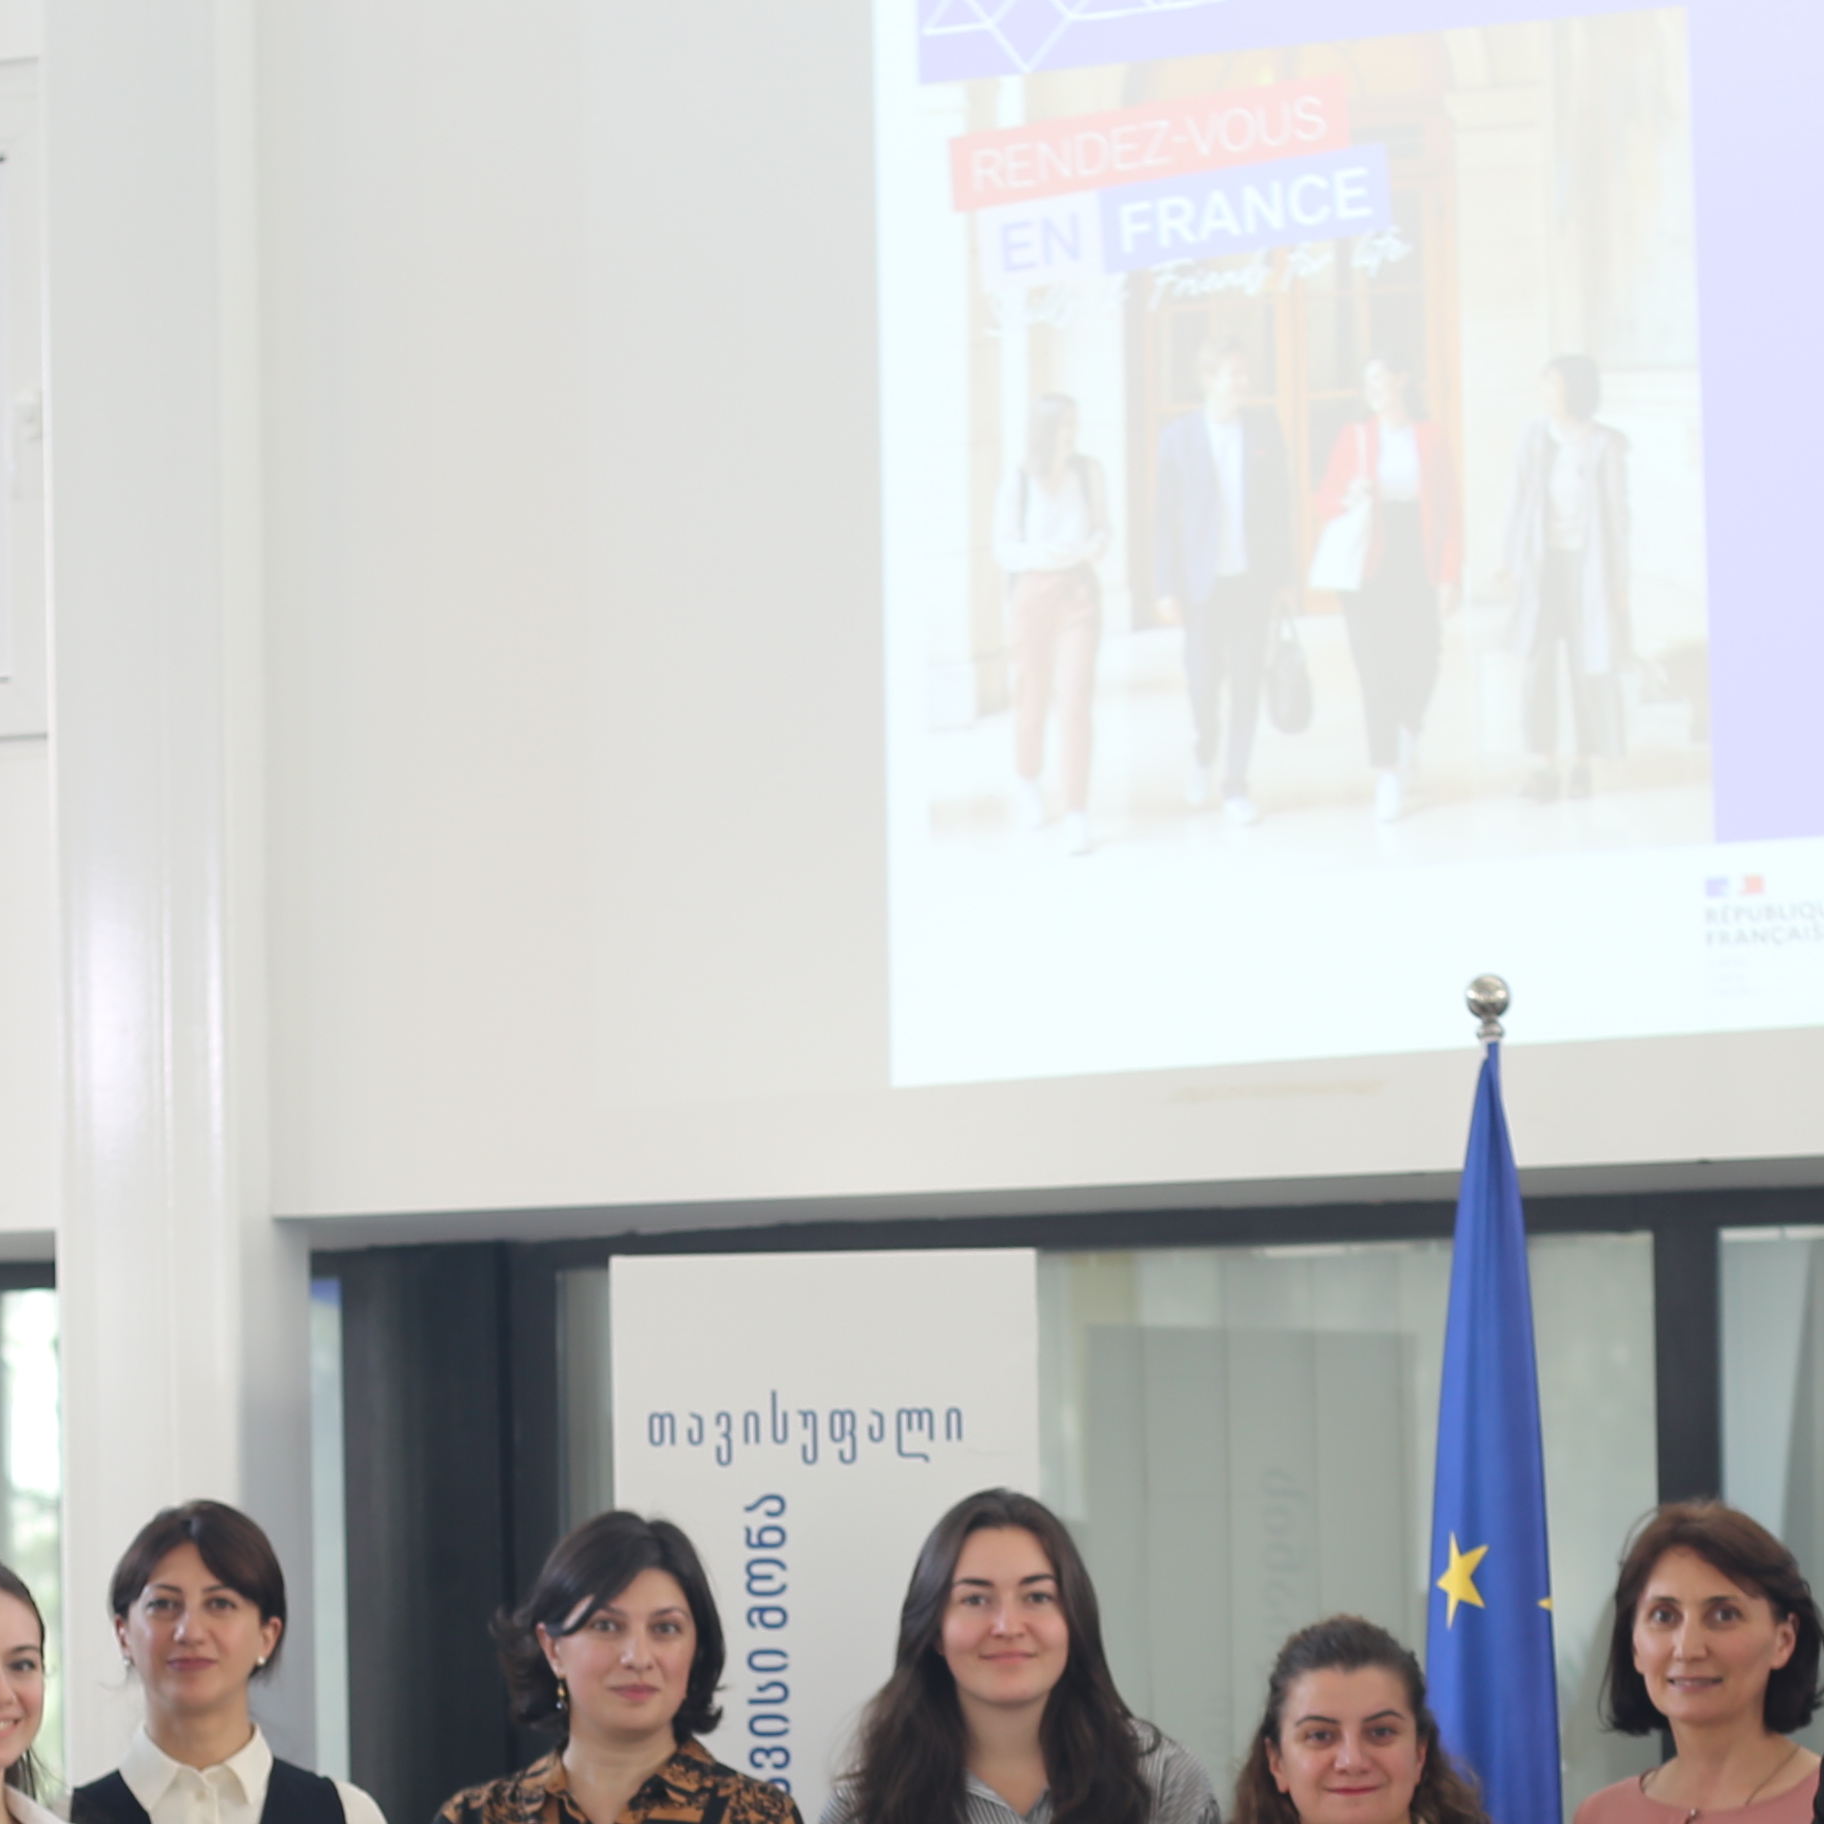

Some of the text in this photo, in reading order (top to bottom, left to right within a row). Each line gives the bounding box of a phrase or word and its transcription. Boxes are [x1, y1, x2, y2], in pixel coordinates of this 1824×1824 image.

[970, 94, 1327, 195] RENDEZ-VOUS
[999, 165, 1373, 273] EN FRANCE
[647, 1390, 964, 1467] თავისუფალი
